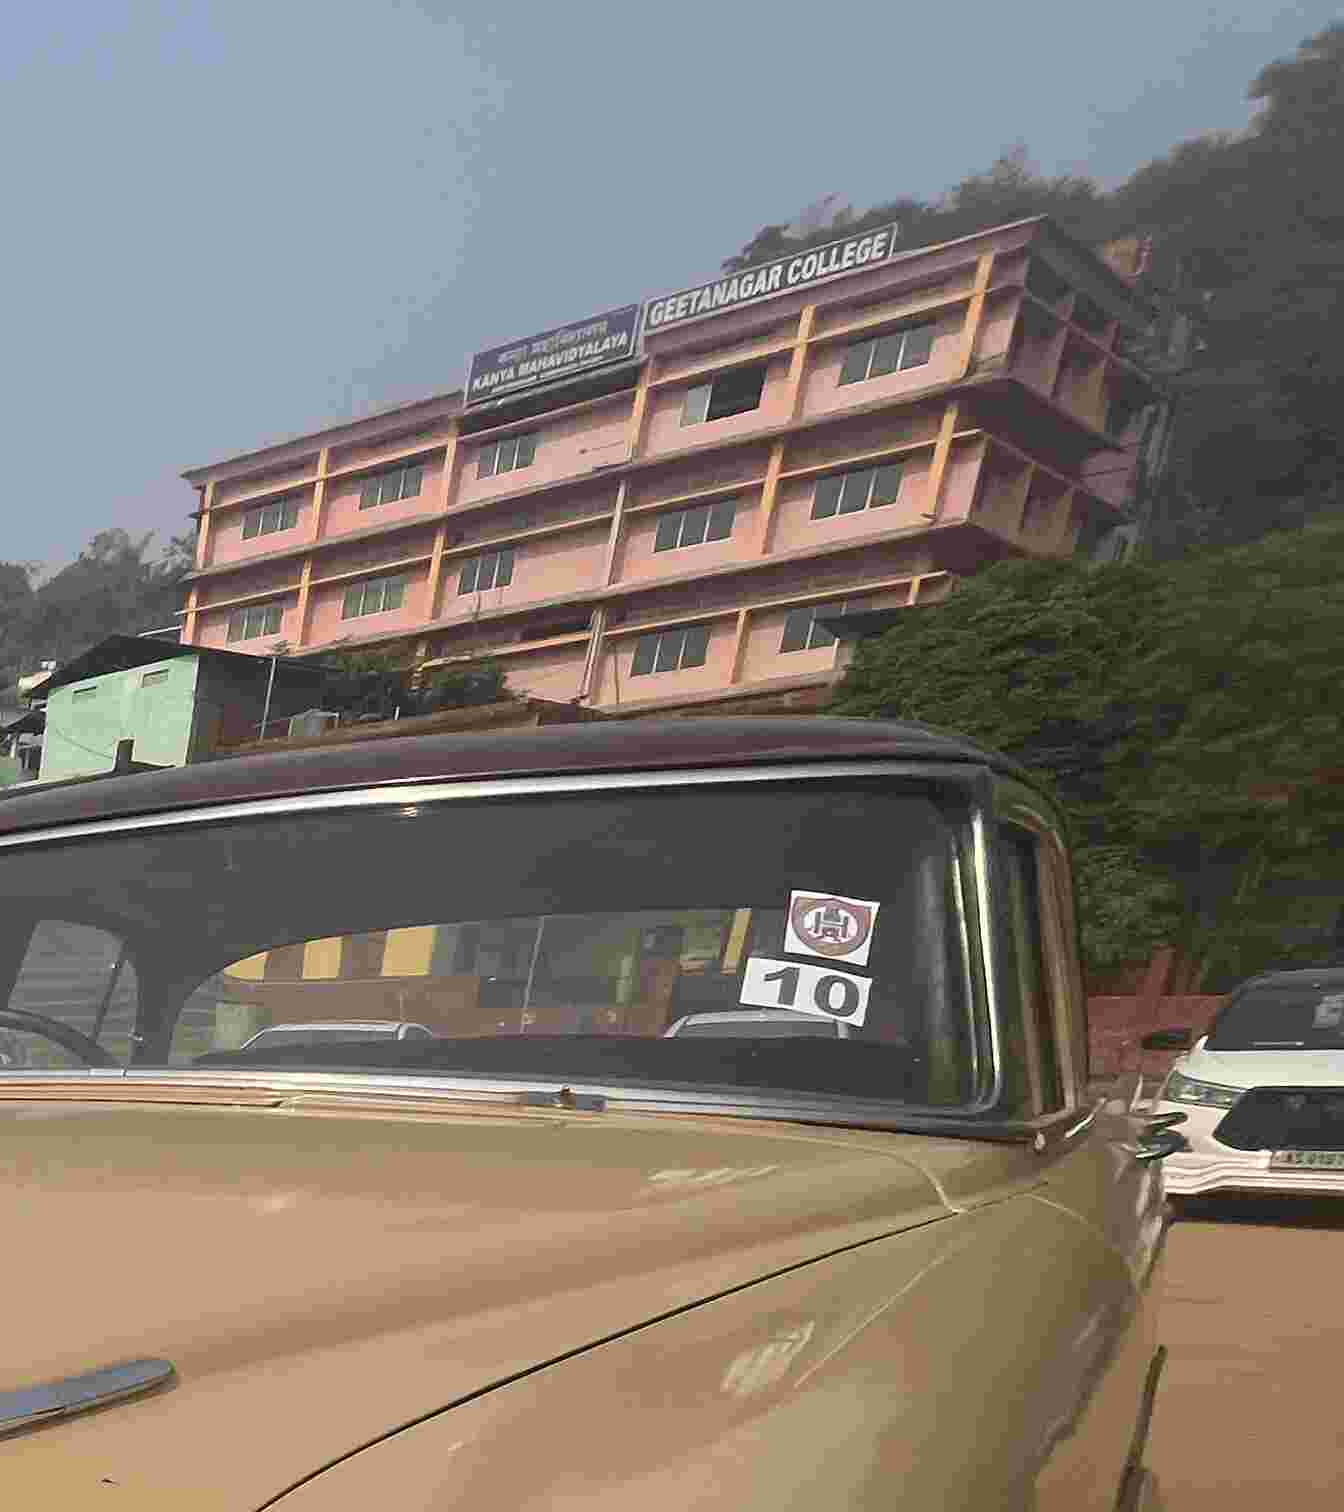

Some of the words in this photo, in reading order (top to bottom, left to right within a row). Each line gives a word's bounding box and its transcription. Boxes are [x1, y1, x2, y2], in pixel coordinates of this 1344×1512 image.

[650, 264, 783, 327] GEETANAGAR
[786, 231, 889, 285] COLLEGE
[764, 966, 860, 1017] 10
